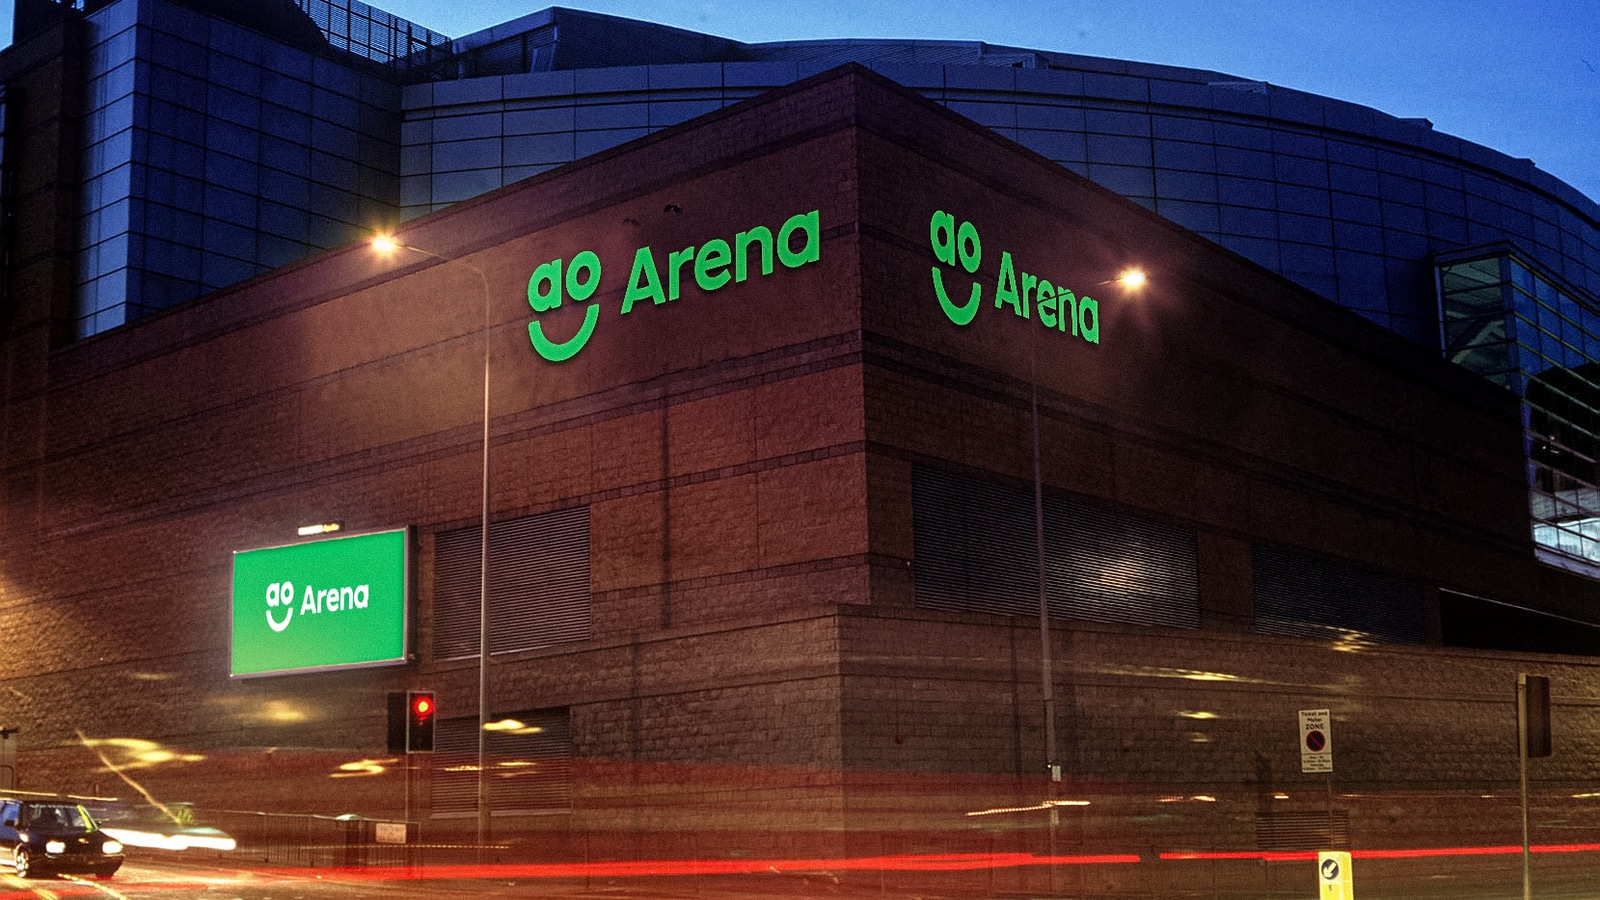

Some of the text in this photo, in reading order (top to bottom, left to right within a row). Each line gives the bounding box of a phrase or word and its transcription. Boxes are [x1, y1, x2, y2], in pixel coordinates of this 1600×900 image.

[528, 210, 820, 315] ao Arena
[931, 210, 1100, 345] ao Arena
[265, 581, 369, 616] ao Arena
